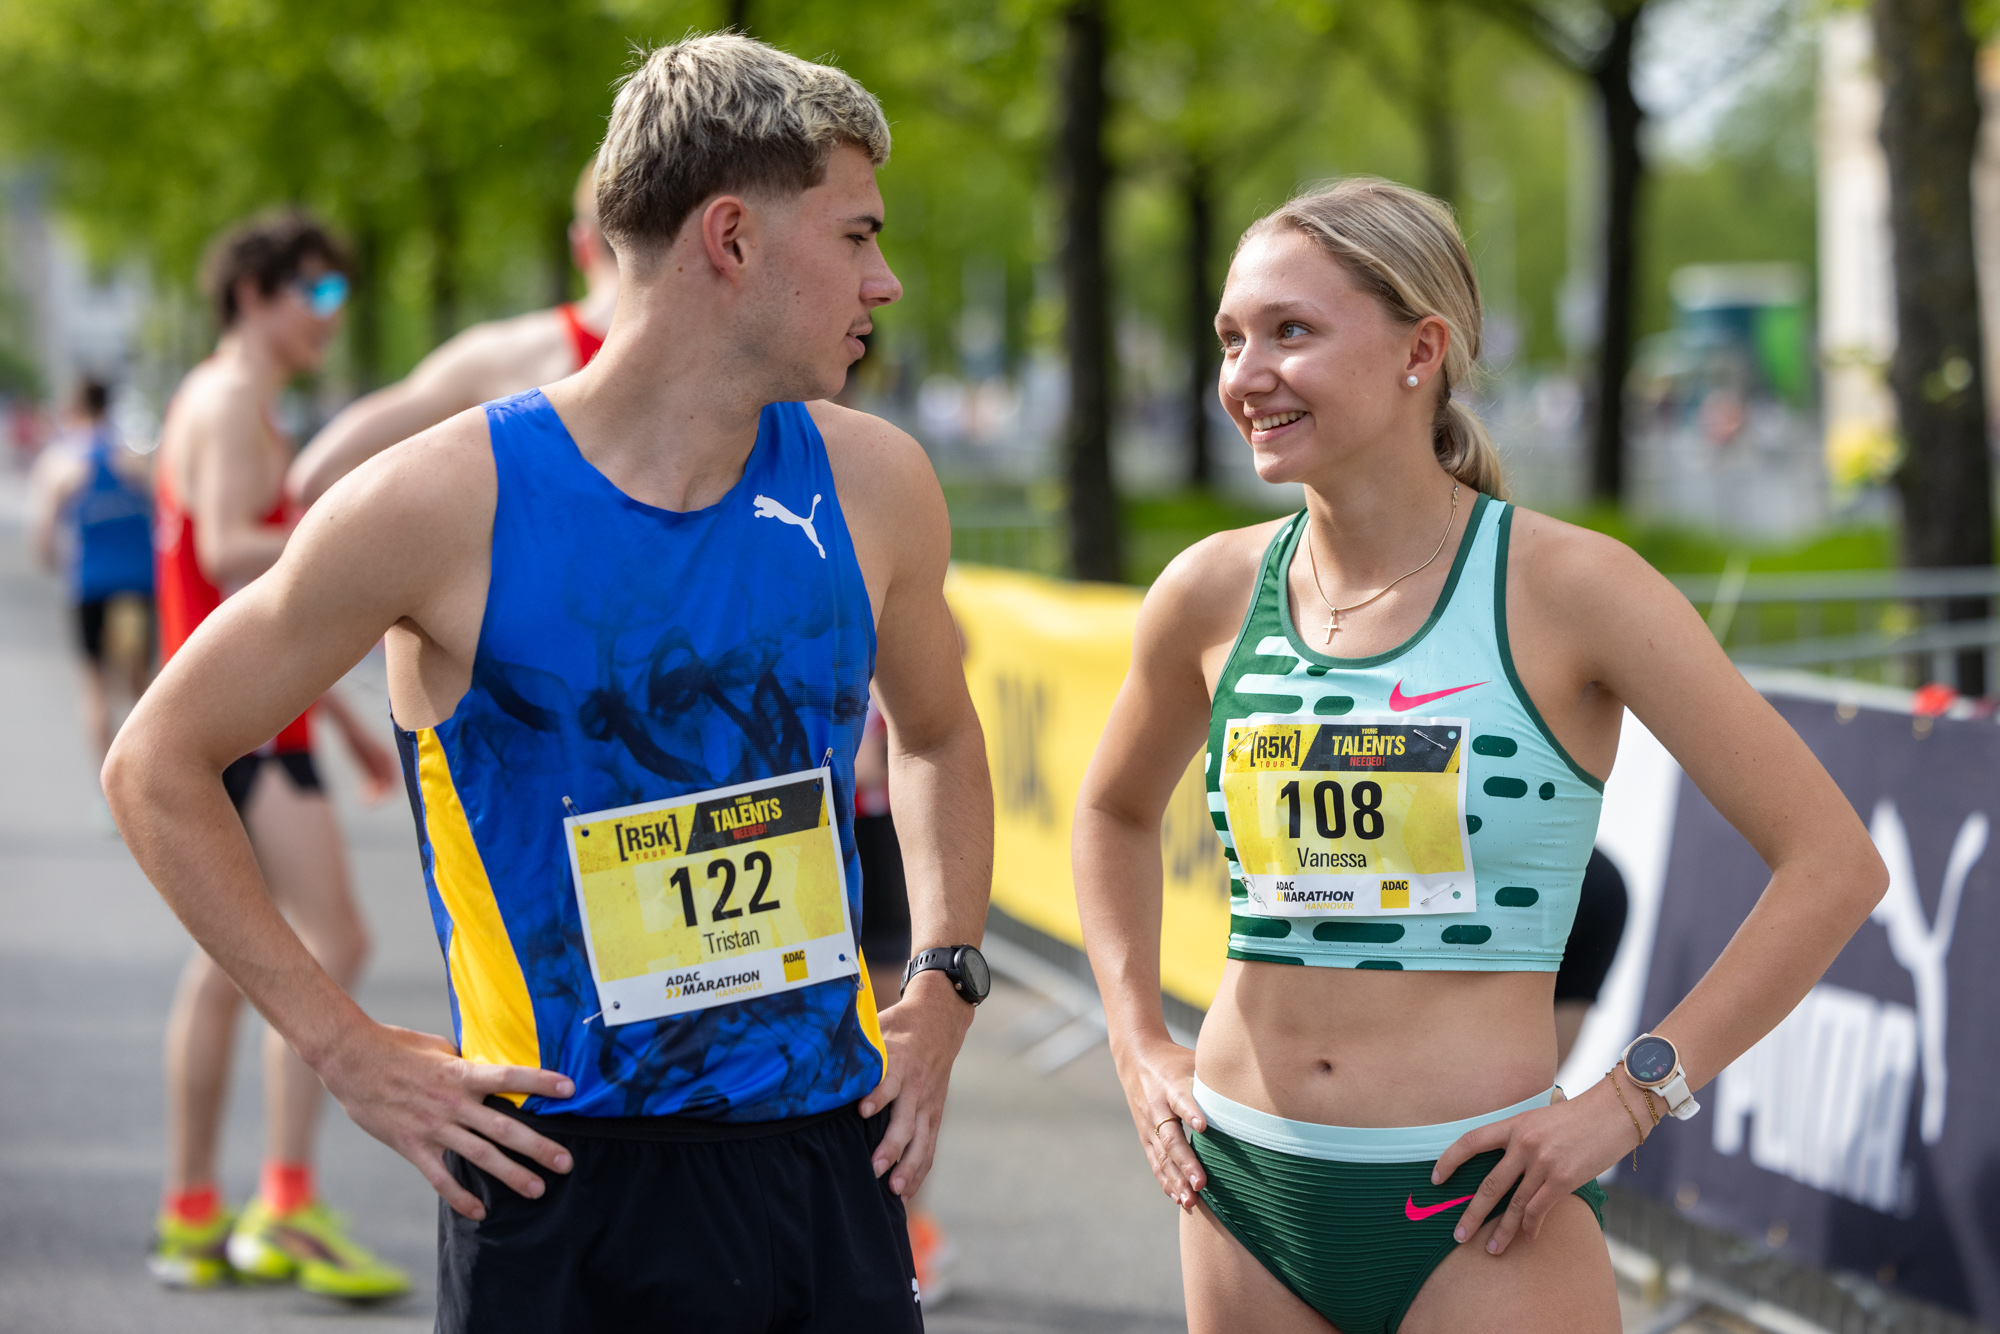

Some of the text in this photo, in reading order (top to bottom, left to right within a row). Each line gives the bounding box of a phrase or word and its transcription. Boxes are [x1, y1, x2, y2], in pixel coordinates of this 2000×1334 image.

[1332, 735, 1406, 756] TALENTS
[1260, 760, 1286, 769] TOUR
[1349, 756, 1386, 767] NEEDED!
[710, 798, 782, 833] TALENTS
[1280, 780, 1385, 840] 108
[732, 823, 768, 841] NEEDED!
[635, 848, 667, 861] TOUR
[1296, 847, 1367, 868] Vanessa
[669, 850, 781, 928] 122
[1276, 881, 1295, 890] ADAC
[1381, 881, 1408, 891] ADAC
[1283, 891, 1354, 902] MARATHON
[1304, 902, 1354, 910] HANNOVER
[703, 928, 760, 954] Tristan
[783, 950, 806, 965] ADAC
[665, 971, 701, 988] ADAC
[682, 970, 760, 997] MARATHON
[715, 982, 763, 999] HANNOVER
